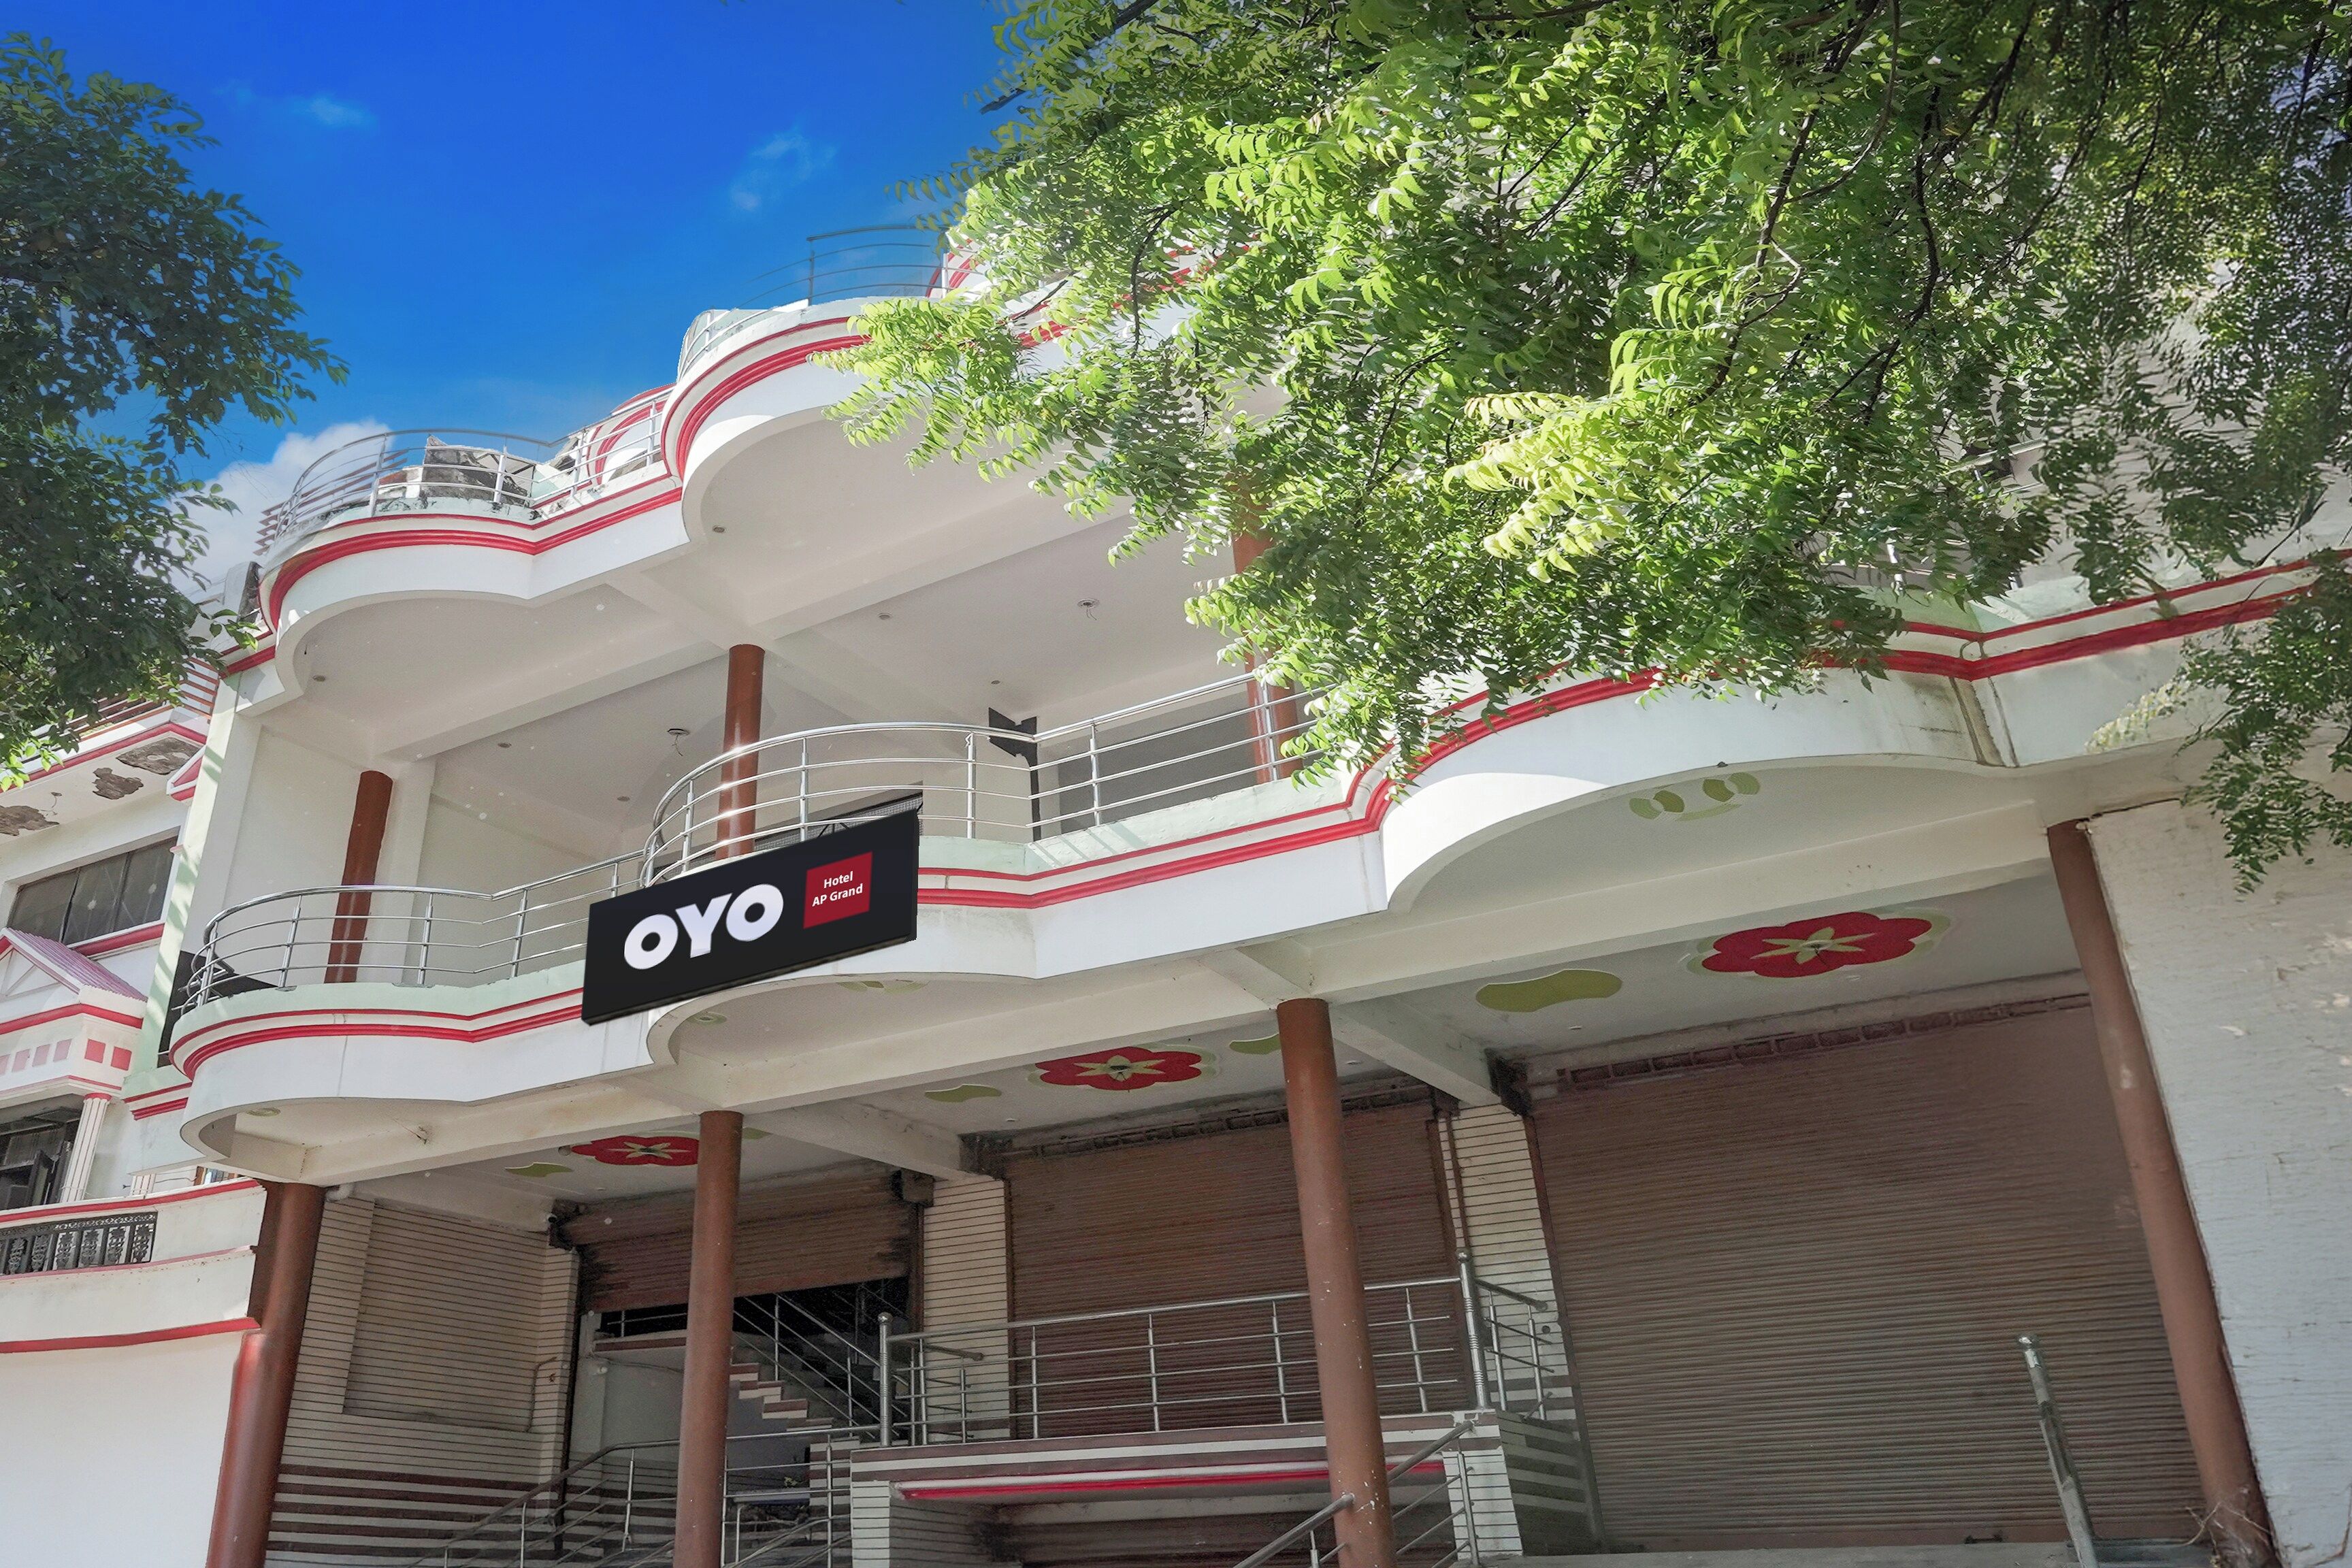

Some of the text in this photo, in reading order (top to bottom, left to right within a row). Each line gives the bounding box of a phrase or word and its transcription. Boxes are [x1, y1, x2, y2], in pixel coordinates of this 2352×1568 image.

[823, 871, 853, 889] Hotel
[812, 883, 863, 906] AP Grand
[624, 884, 783, 969] OYO
